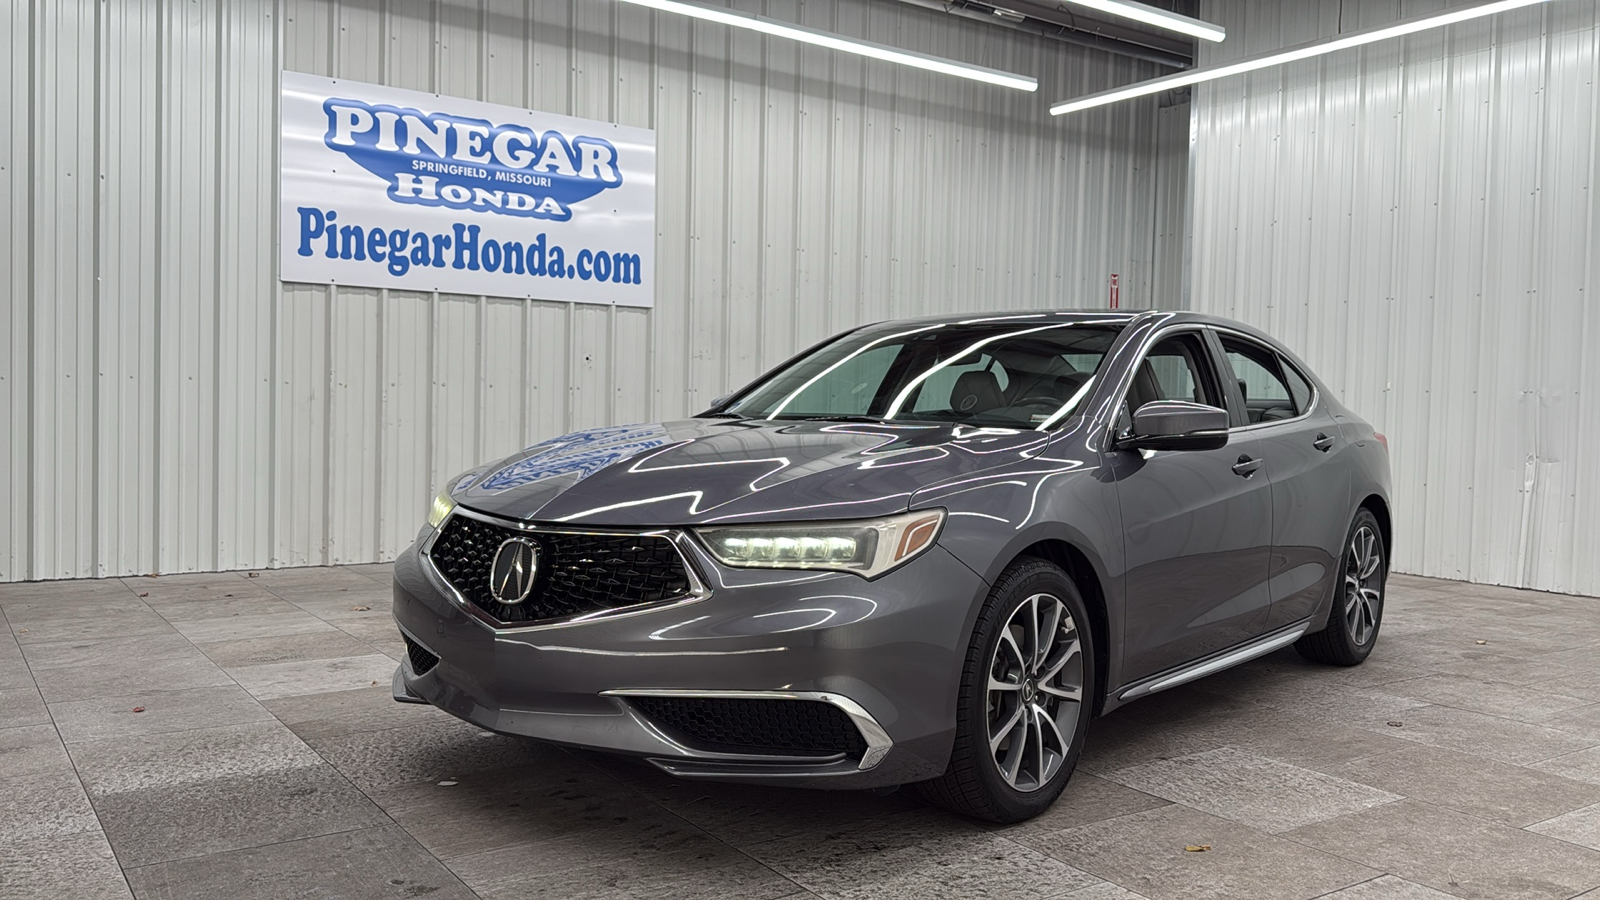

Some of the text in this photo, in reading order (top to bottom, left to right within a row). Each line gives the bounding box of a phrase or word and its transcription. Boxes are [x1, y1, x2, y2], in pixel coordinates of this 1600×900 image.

[331, 105, 618, 182] PINEGAR
[394, 173, 566, 215] HONDA
[412, 160, 551, 187] SPRINGFIELD, MISSOURI
[297, 207, 642, 285] PinegarHonda.com
